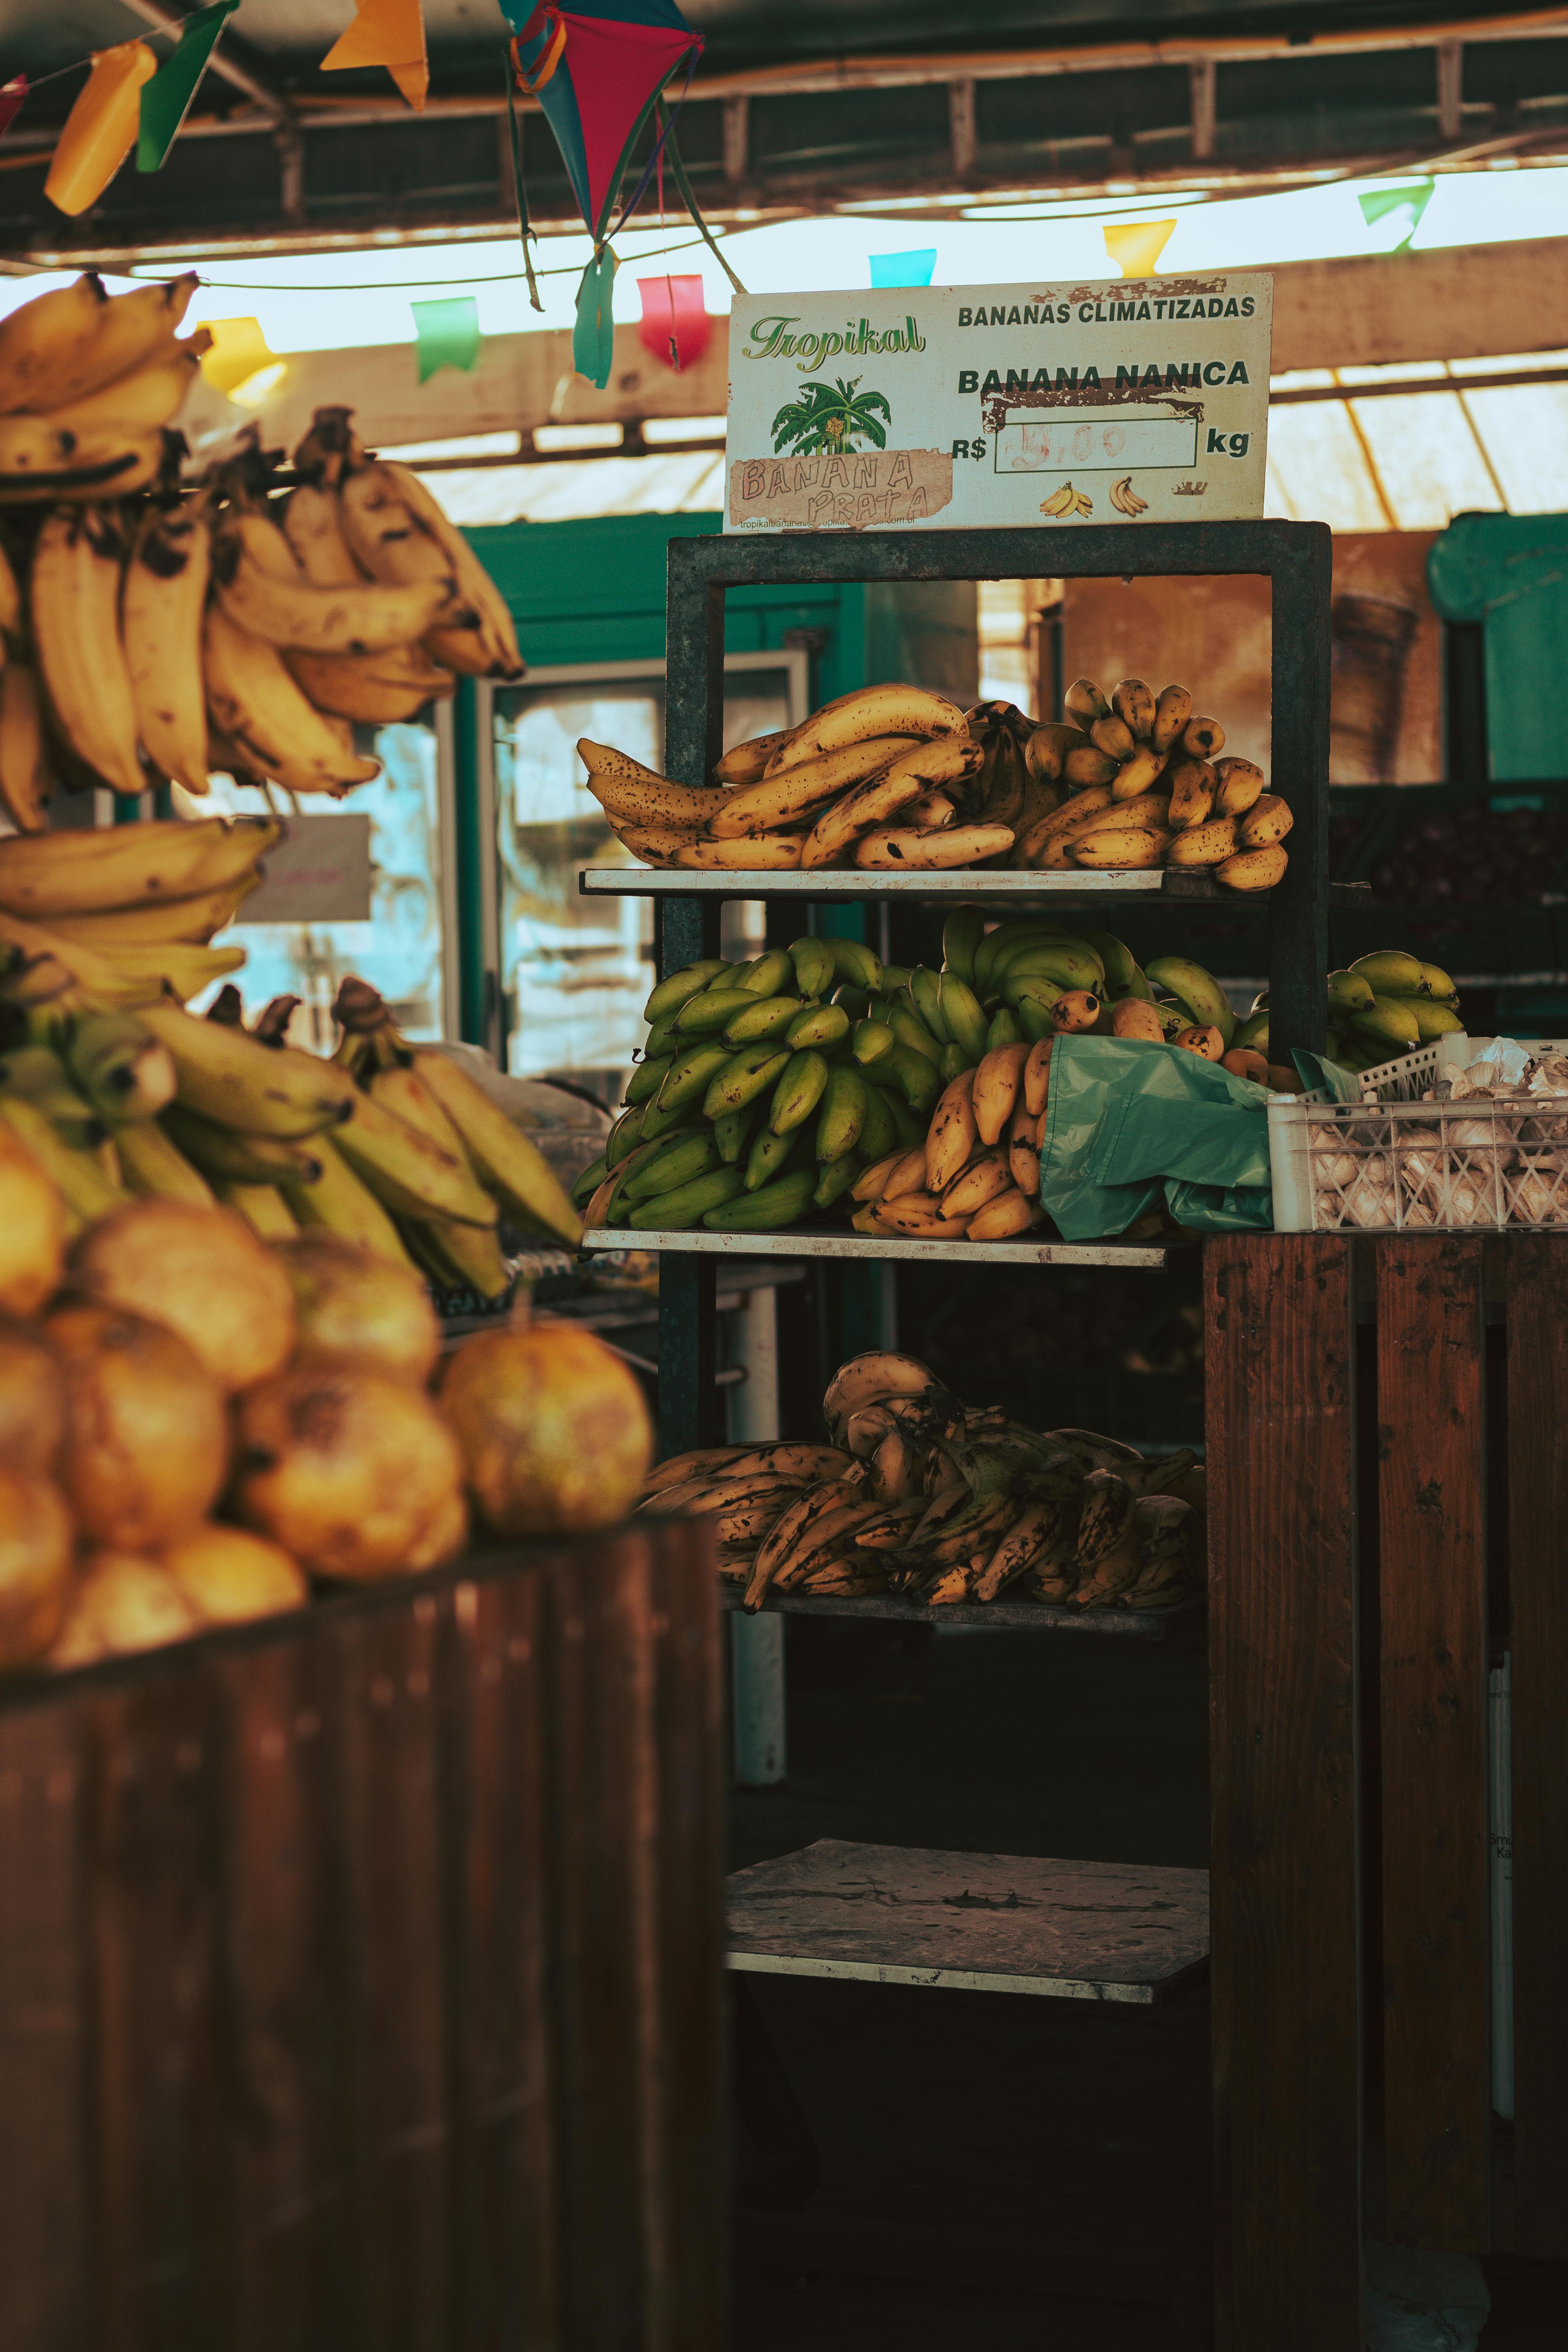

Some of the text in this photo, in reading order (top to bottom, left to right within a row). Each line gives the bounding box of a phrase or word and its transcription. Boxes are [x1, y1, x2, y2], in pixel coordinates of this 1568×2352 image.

[958, 296, 1256, 326] BANANAS CLIMATIZADAS
[742, 316, 926, 373] Tropikal
[958, 361, 1250, 394] BANANA NANICA
[952, 437, 987, 461] R$
[1207, 428, 1250, 457] kg
[742, 453, 913, 499] BANANA
